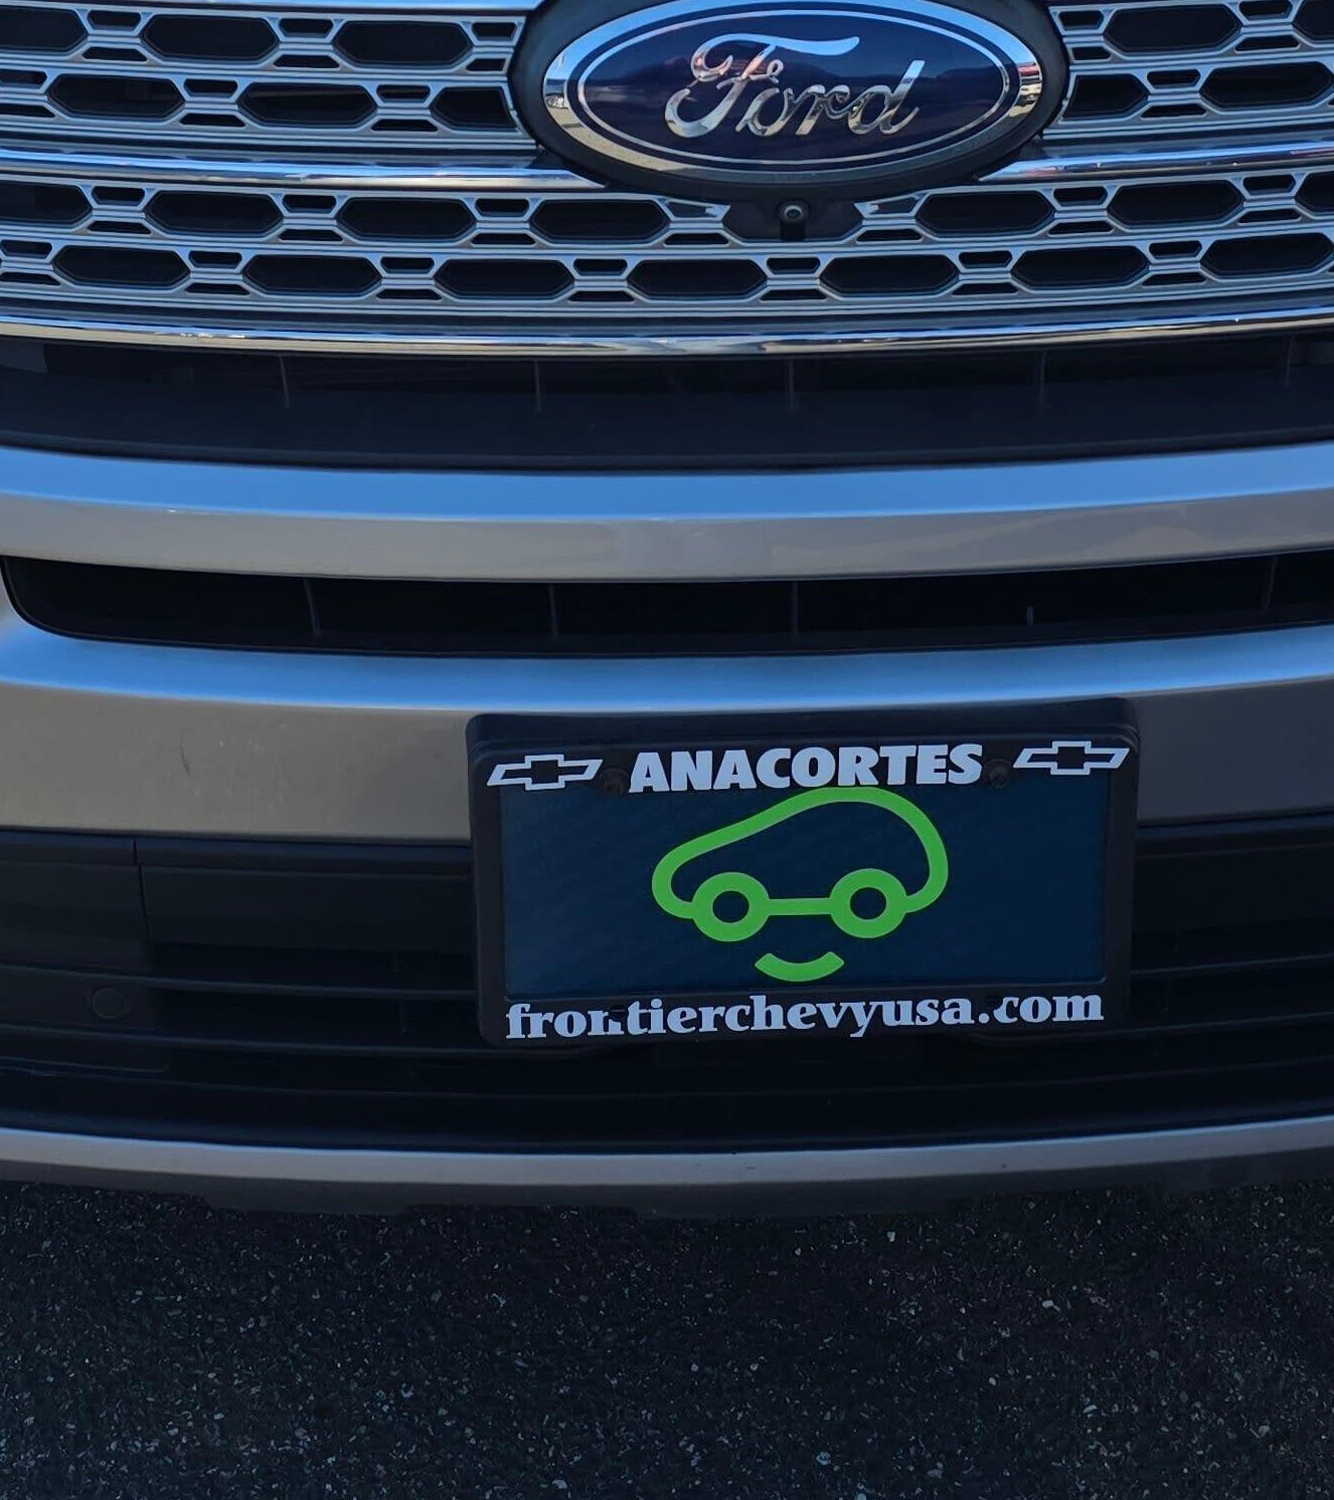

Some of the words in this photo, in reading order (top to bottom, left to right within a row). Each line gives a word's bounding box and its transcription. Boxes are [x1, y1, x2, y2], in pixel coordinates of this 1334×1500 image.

[665, 33, 925, 139] Ford
[628, 743, 983, 794] ANACORTES
[505, 993, 1104, 1039] frontierchevyusa.com
